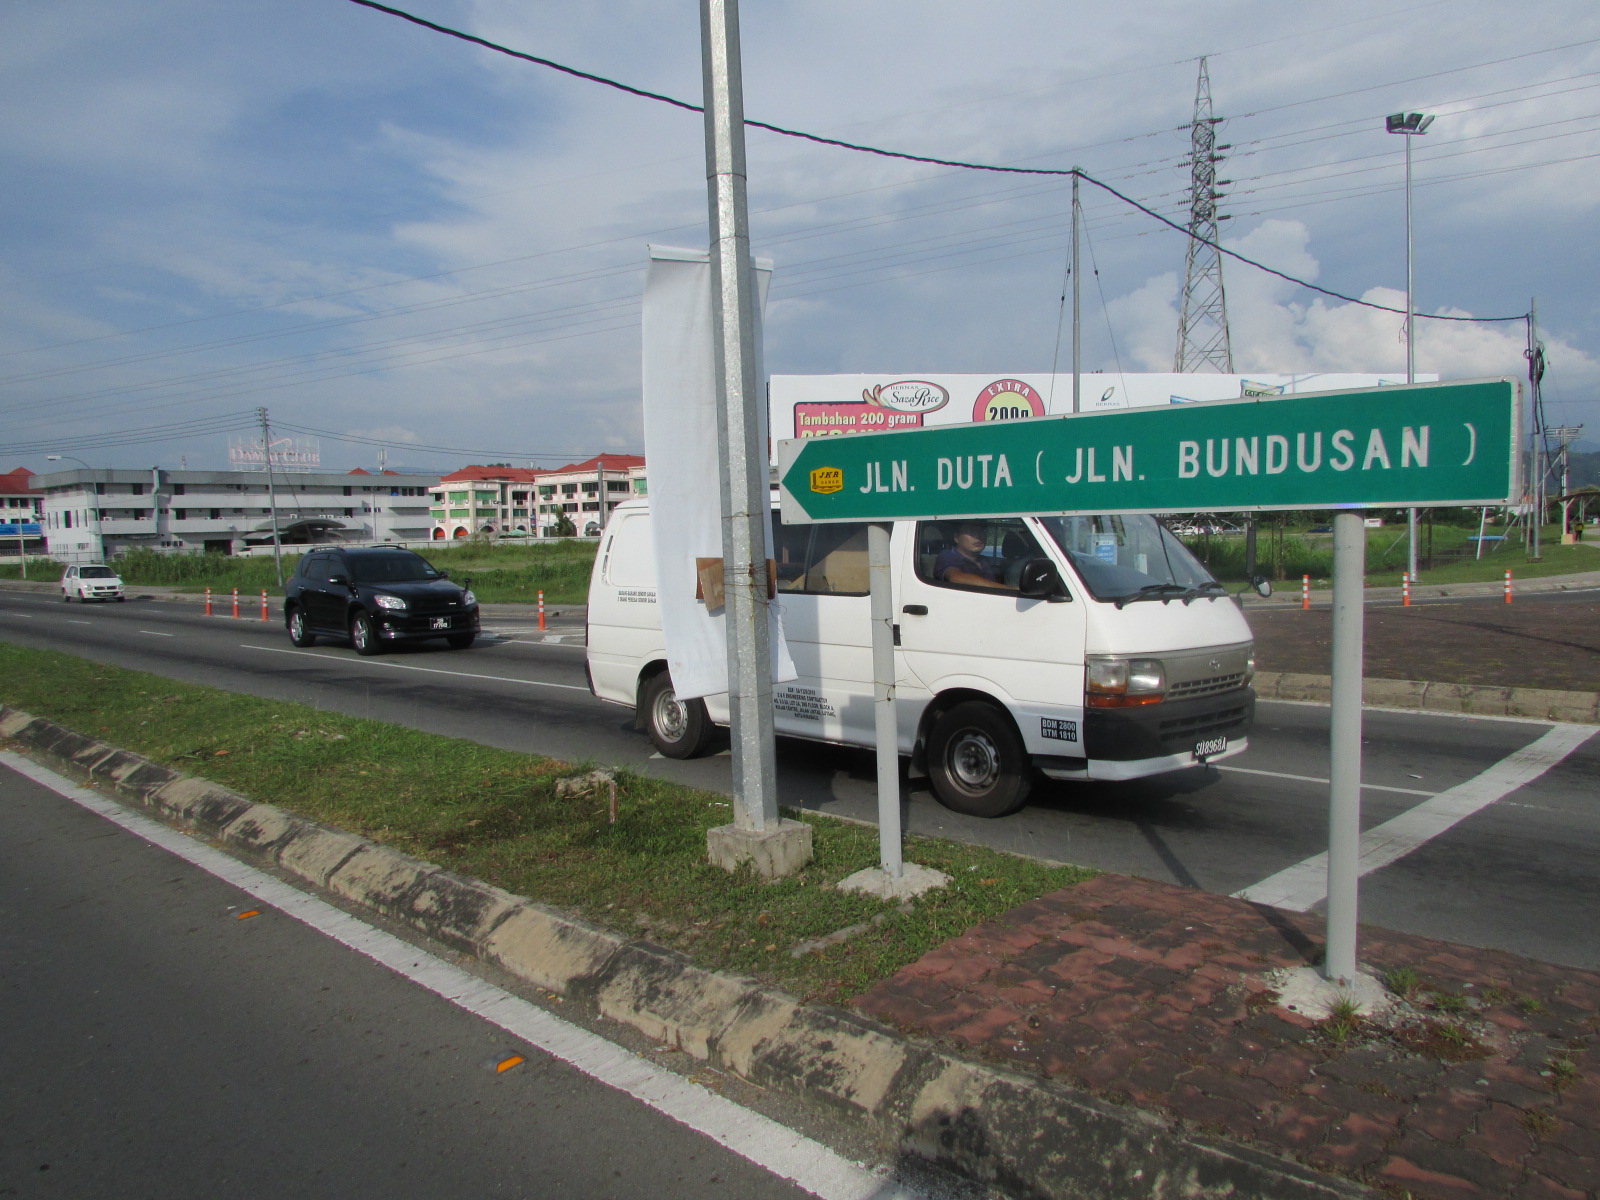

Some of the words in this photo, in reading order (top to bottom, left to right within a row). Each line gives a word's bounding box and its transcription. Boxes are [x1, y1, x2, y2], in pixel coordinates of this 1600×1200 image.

[988, 381, 1030, 397] EXTRA
[798, 412, 856, 426] Tambahan
[860, 412, 885, 425] 200
[888, 413, 917, 427] gram
[859, 460, 915, 493] JLN.
[937, 453, 1013, 490] DUTA
[1065, 445, 1145, 483] JLN.
[1178, 425, 1429, 479] BUNDUSAN
[1059, 721, 1076, 732] 2800
[1042, 728, 1058, 738] BTM
[1059, 730, 1076, 741] 1810
